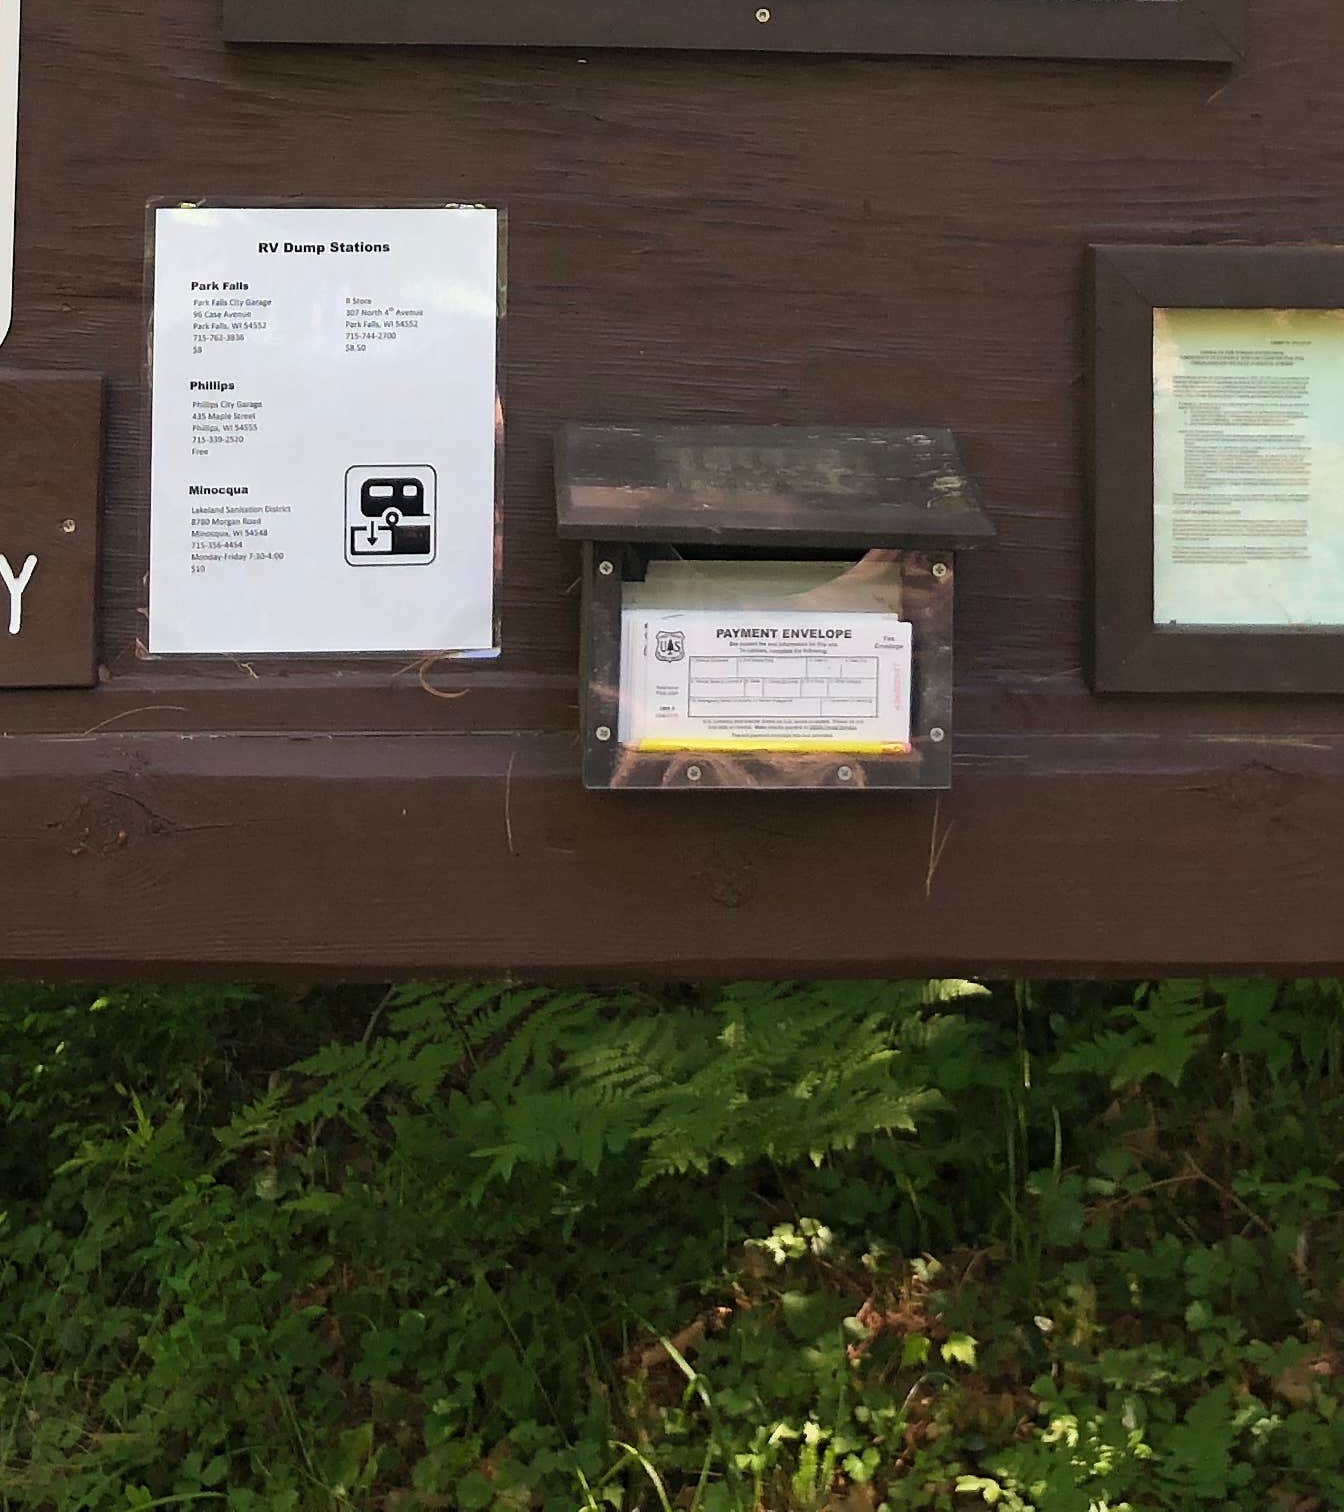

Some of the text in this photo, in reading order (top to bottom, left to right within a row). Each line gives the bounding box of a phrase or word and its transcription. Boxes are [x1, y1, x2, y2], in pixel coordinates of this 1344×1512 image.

[259, 241, 390, 255] RV Dump Stations
[191, 281, 249, 291] Park Falls
[190, 381, 234, 392] Phillips
[189, 486, 248, 496] Minocqua
[716, 628, 852, 639] PAYMENT ENVELOPE
